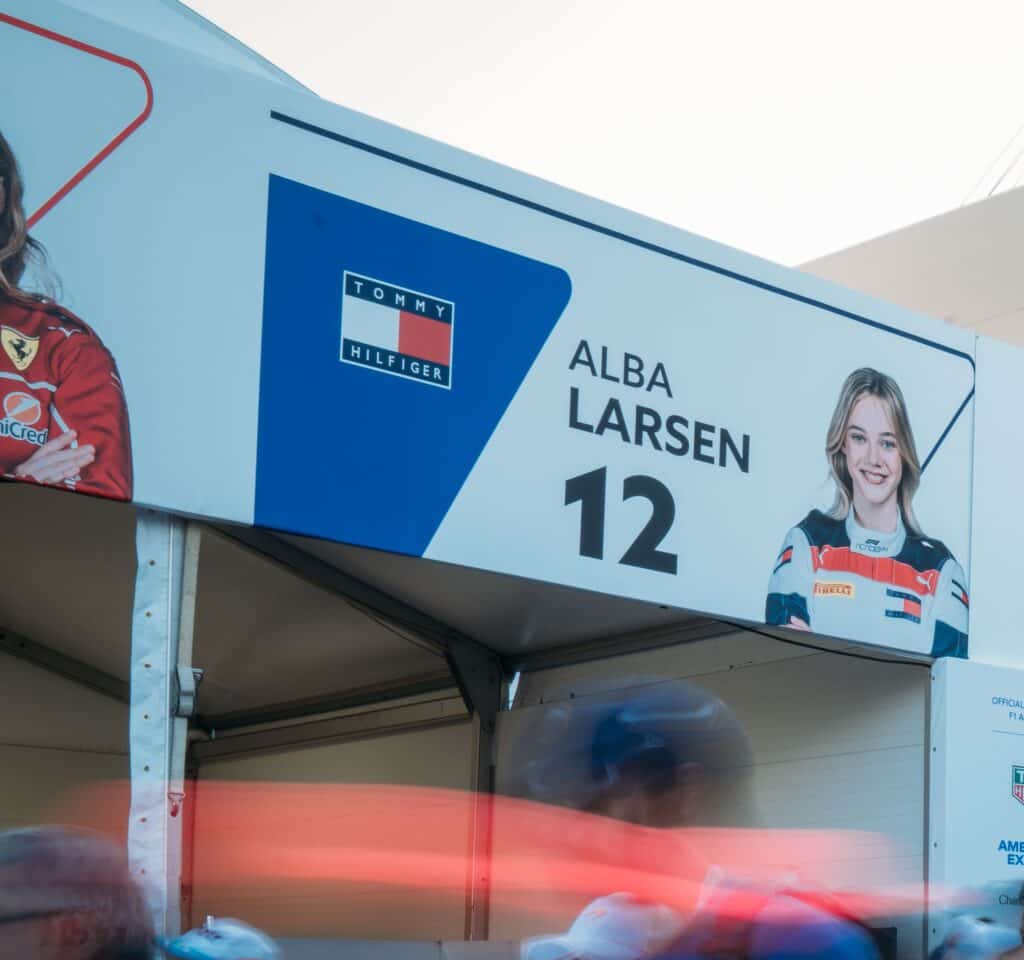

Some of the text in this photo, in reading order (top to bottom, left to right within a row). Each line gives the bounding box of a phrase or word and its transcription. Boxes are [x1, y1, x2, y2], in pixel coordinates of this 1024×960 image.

[354, 280, 445, 318] TOMMY
[350, 344, 442, 381] HILFIGER
[568, 339, 674, 399] ALBA
[569, 386, 750, 473] LARSEN
[564, 465, 678, 576] 12
[991, 697, 1024, 709] OFFICIAL
